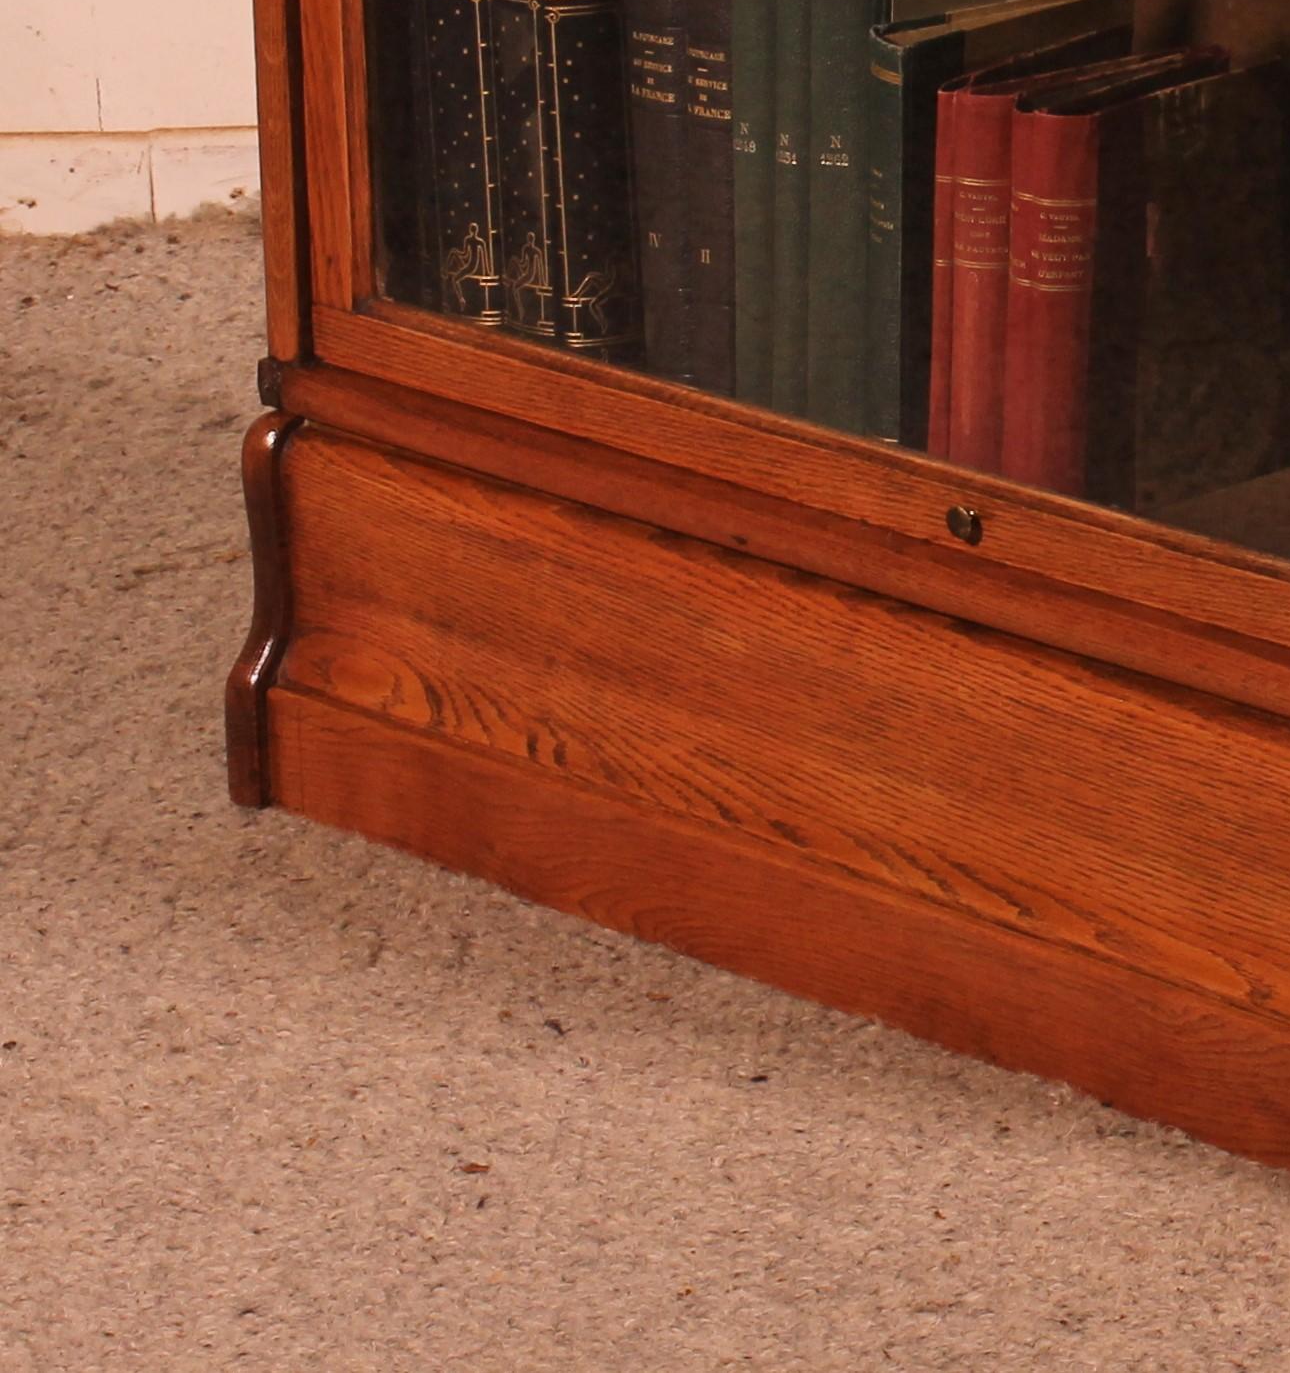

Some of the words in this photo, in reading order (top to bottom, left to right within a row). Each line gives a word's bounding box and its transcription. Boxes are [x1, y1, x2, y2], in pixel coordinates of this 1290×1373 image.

[696, 78, 728, 90] SERVICE
[641, 88, 675, 102] FRANCE
[693, 105, 731, 119] FRANCE
[780, 133, 789, 146] N
[830, 135, 841, 148] N
